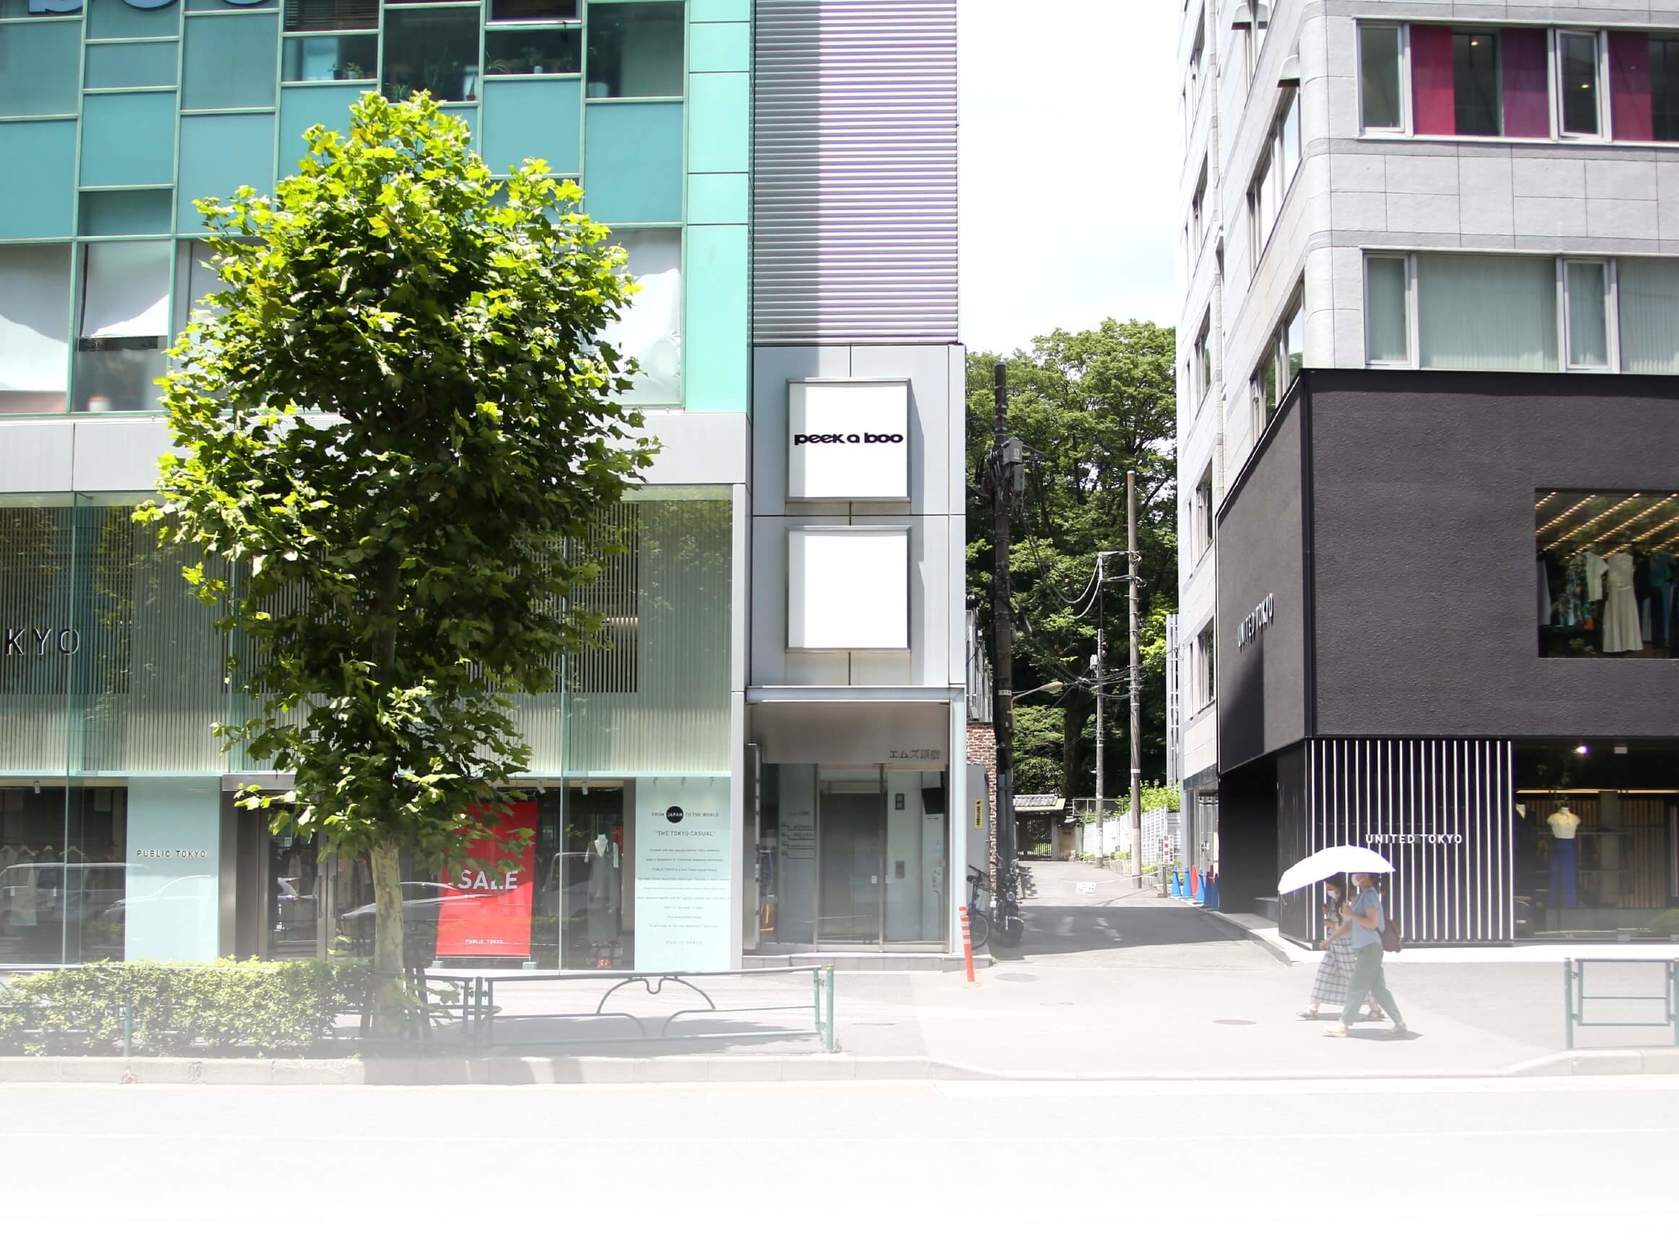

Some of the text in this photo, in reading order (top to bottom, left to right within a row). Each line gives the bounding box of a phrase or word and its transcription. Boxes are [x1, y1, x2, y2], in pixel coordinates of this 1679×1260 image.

[794, 432, 904, 446] peek a boo
[1365, 834, 1463, 844] UNITED TOKYO
[136, 849, 206, 858] PUBLIC TOKYO
